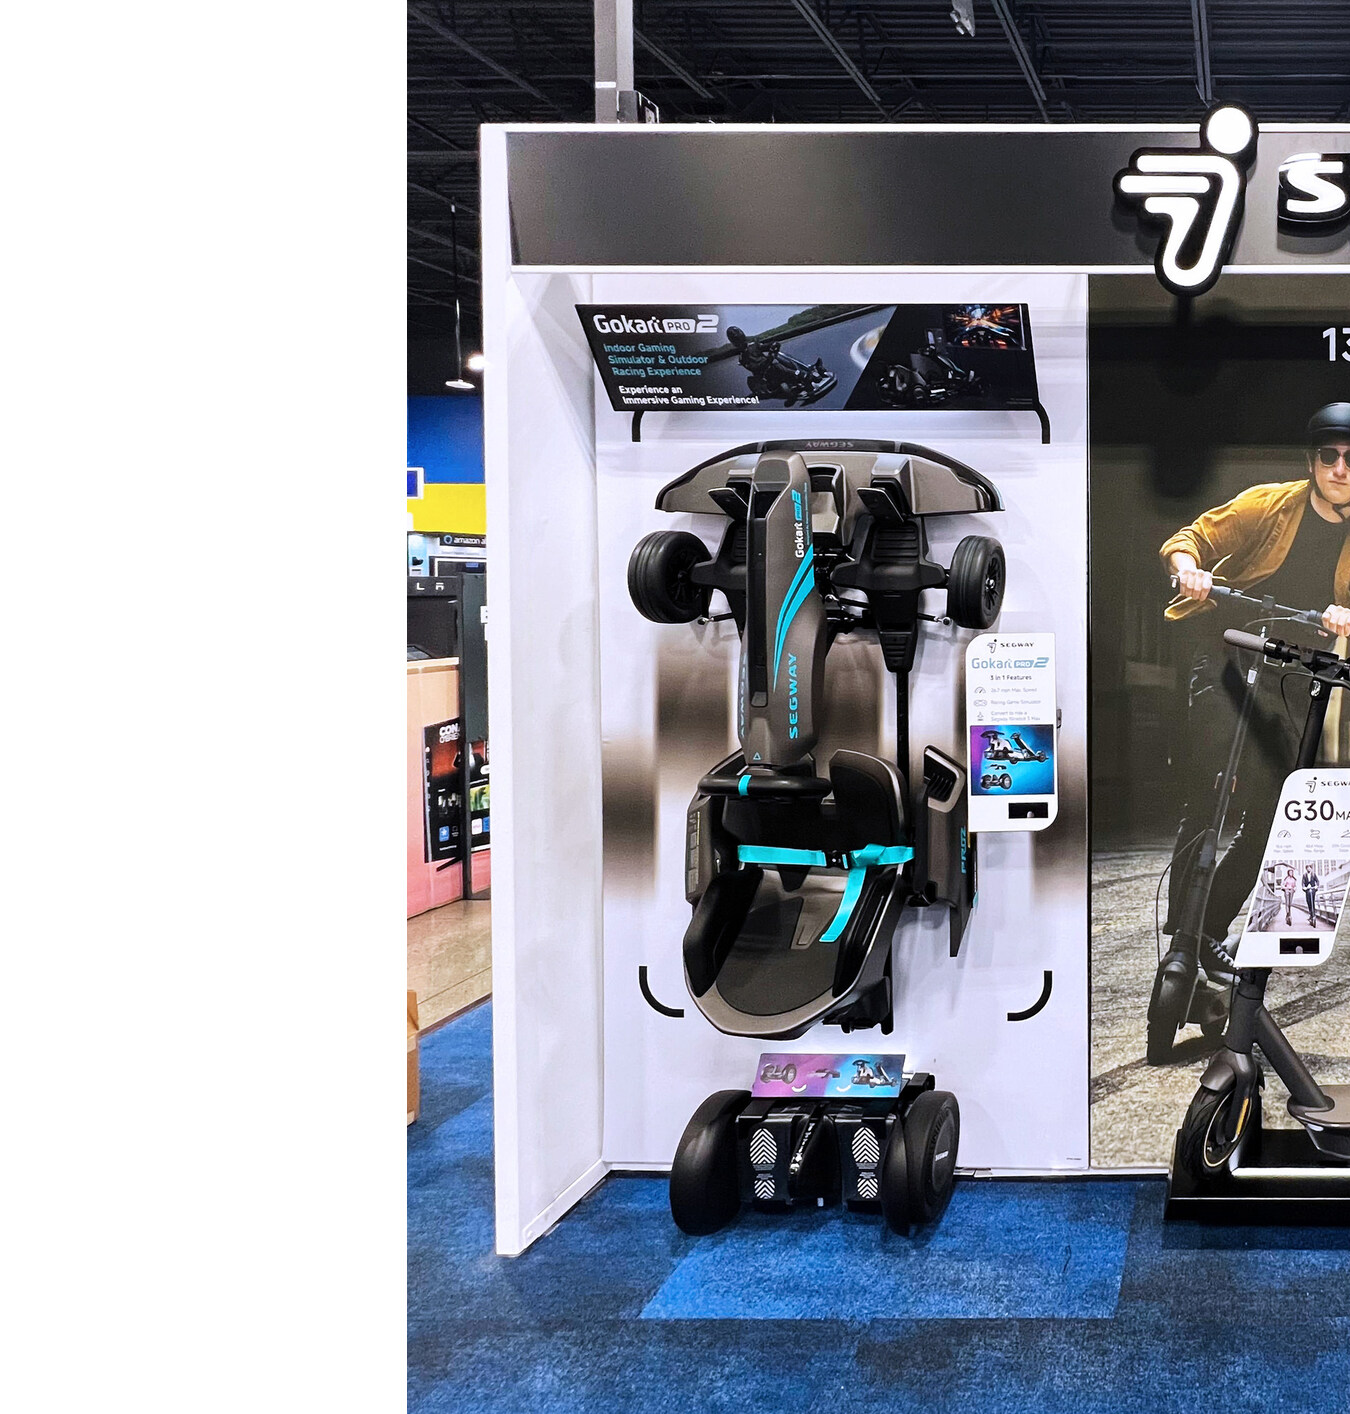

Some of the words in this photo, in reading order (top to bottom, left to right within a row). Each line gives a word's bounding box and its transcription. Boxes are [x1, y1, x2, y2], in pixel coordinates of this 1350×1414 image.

[592, 314, 664, 334] Gokart
[696, 314, 720, 333] 2
[603, 343, 636, 353] Indoor
[638, 343, 676, 355] Gaming
[608, 355, 655, 365] Simulator
[658, 356, 666, 365] &
[668, 355, 709, 365] Outdoor
[612, 367, 646, 378] Racing
[648, 367, 702, 378] Experience
[618, 386, 670, 396] Experience
[671, 387, 683, 395] an
[622, 396, 670, 405] Immersive
[670, 396, 706, 407] Gaming
[707, 396, 761, 406] Experience!
[794, 522, 805, 559] Gokart
[971, 657, 1013, 669] Gokart
[1033, 656, 1050, 668] 2
[788, 652, 799, 740] SEGWAY
[1284, 799, 1335, 822] G30
